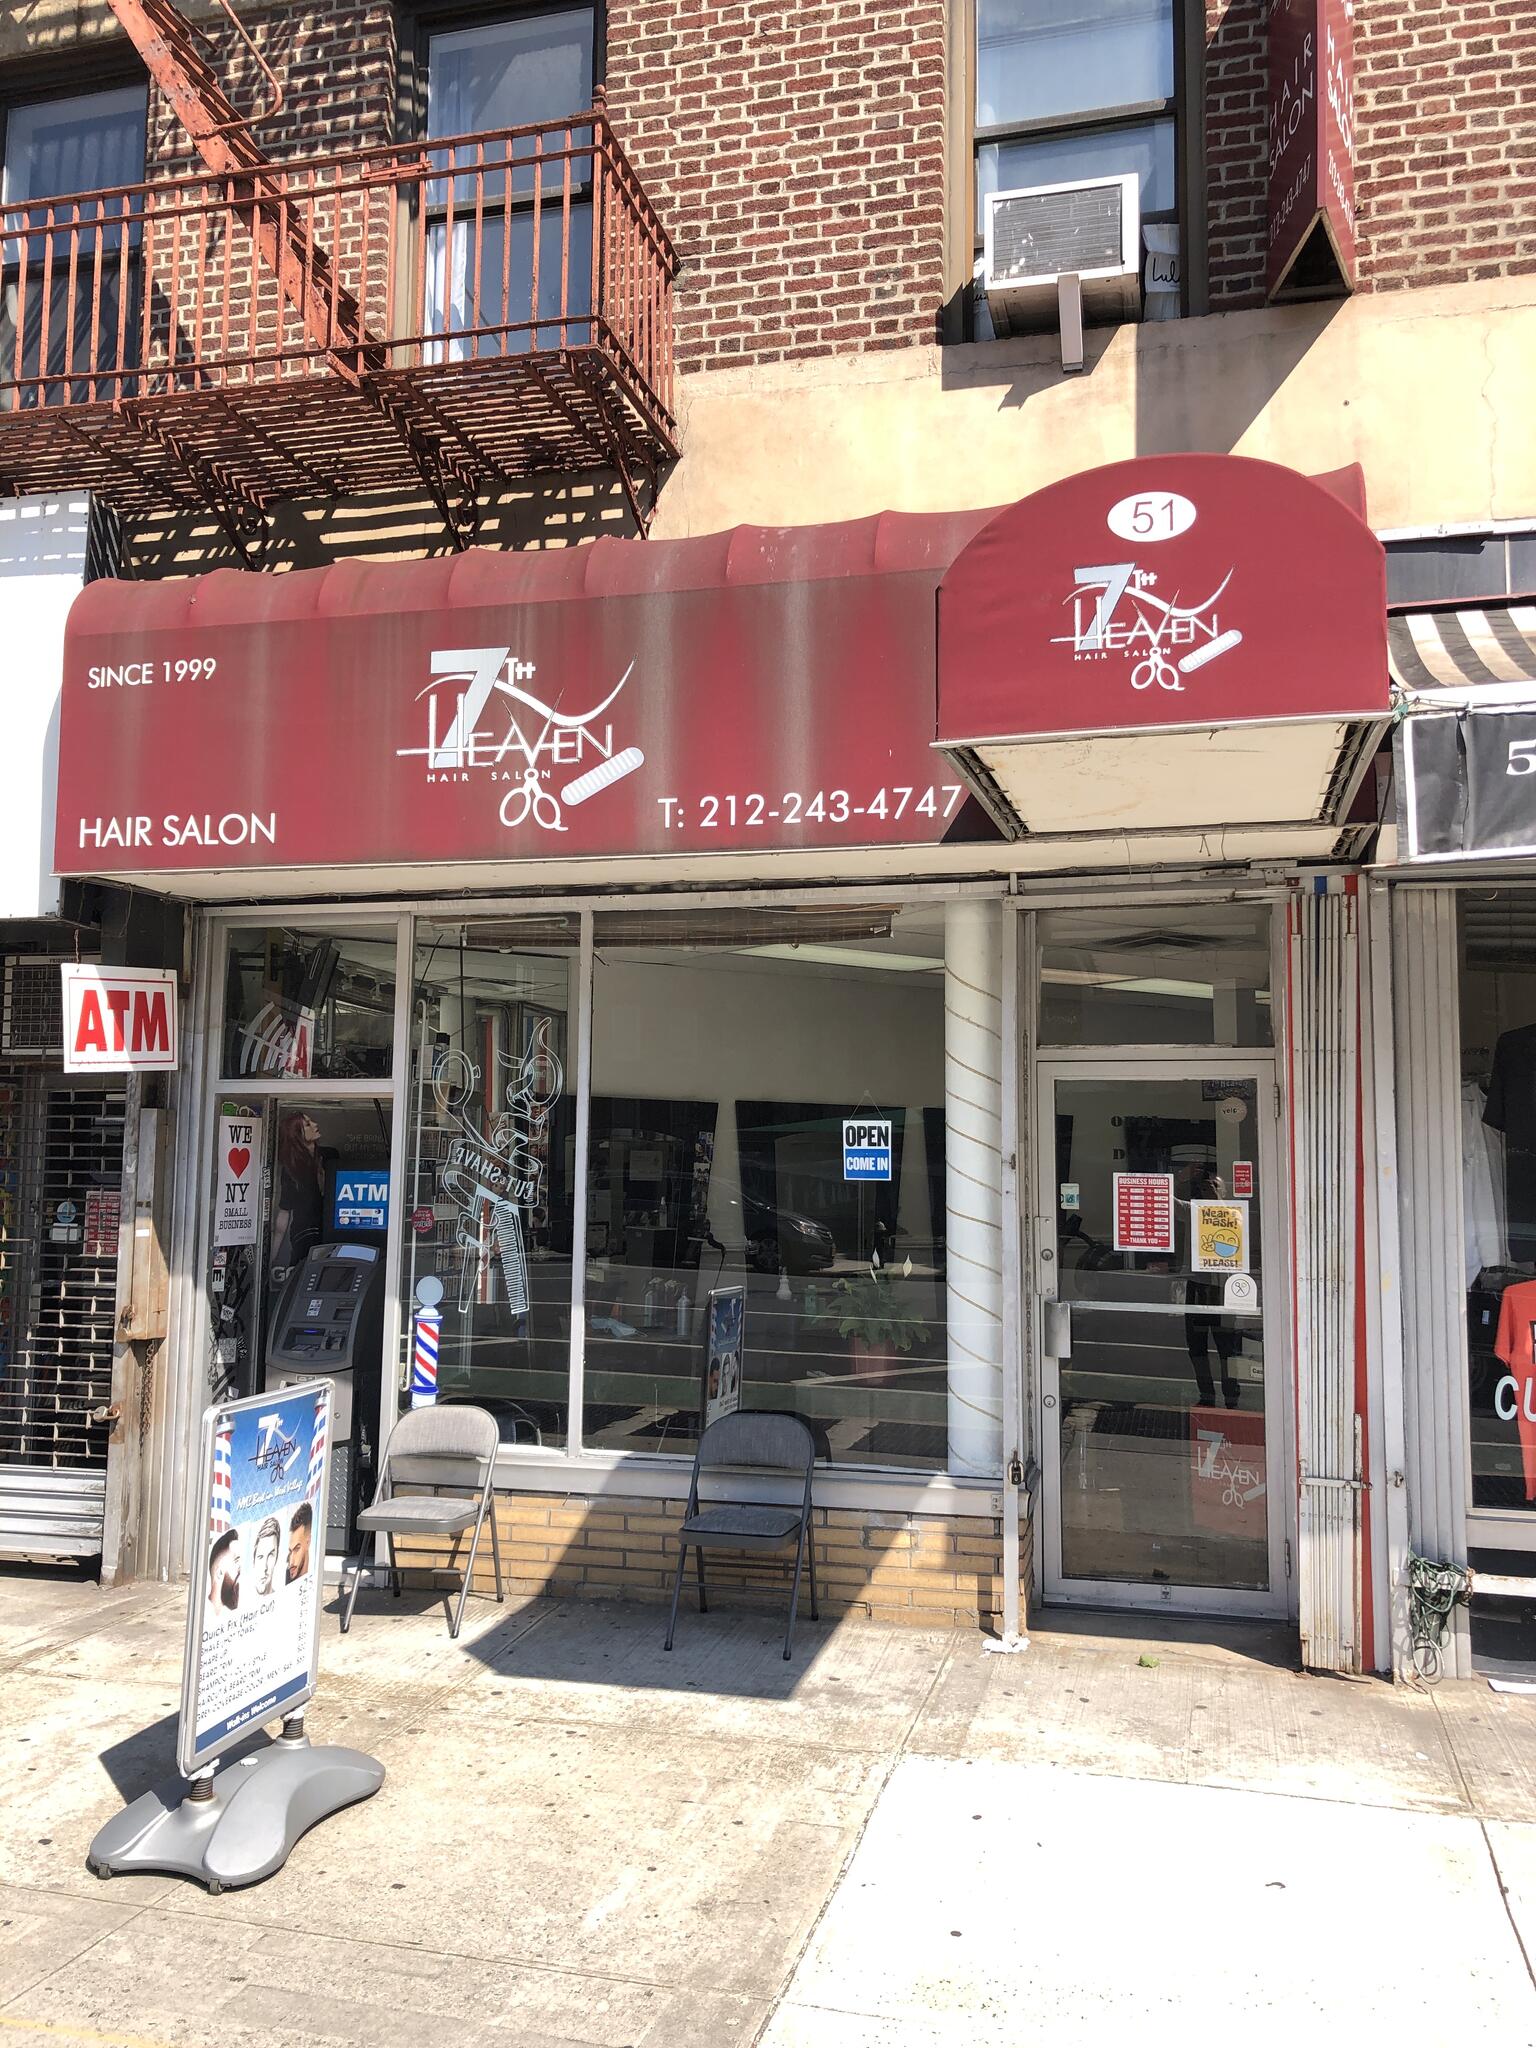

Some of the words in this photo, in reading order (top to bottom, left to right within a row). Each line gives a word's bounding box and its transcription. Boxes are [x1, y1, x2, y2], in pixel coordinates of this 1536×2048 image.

[1269, 32, 1313, 140] HAIR
[1269, 72, 1313, 180] SALON
[1132, 499, 1174, 533] 51
[1050, 594, 1218, 652] HEAVEN
[1074, 652, 1108, 661] HAIR
[1123, 647, 1171, 658] SALON
[87, 663, 153, 689] SINCE
[162, 658, 217, 683] 1999
[397, 690, 613, 769] HEAVEN
[427, 771, 470, 783] HAIR
[491, 769, 551, 781] SALON
[657, 797, 684, 828] T:
[699, 785, 962, 827] 212-243-4747
[79, 816, 152, 848] HAIR
[162, 812, 276, 846] SALON
[75, 990, 170, 1052] ATM
[228, 1124, 253, 1144] WE
[845, 1125, 889, 1147] OPEN
[846, 1157, 876, 1171] COME
[876, 1157, 888, 1171] IN
[1119, 1177, 1148, 1185] BUSINESS
[1148, 1178, 1169, 1186] HOURS
[225, 1183, 250, 1203] NY
[337, 1184, 388, 1201] ATM
[224, 1207, 248, 1217] SMALL
[1201, 1208, 1229, 1218] Wear
[219, 1219, 252, 1230] BUSINESS
[1202, 1216, 1238, 1229] mask!
[1203, 1258, 1238, 1268] PLEASE!
[248, 1435, 297, 1466] HEAVEN
[1190, 1446, 1259, 1485] HEAVEN
[201, 1625, 225, 1643] Quick
